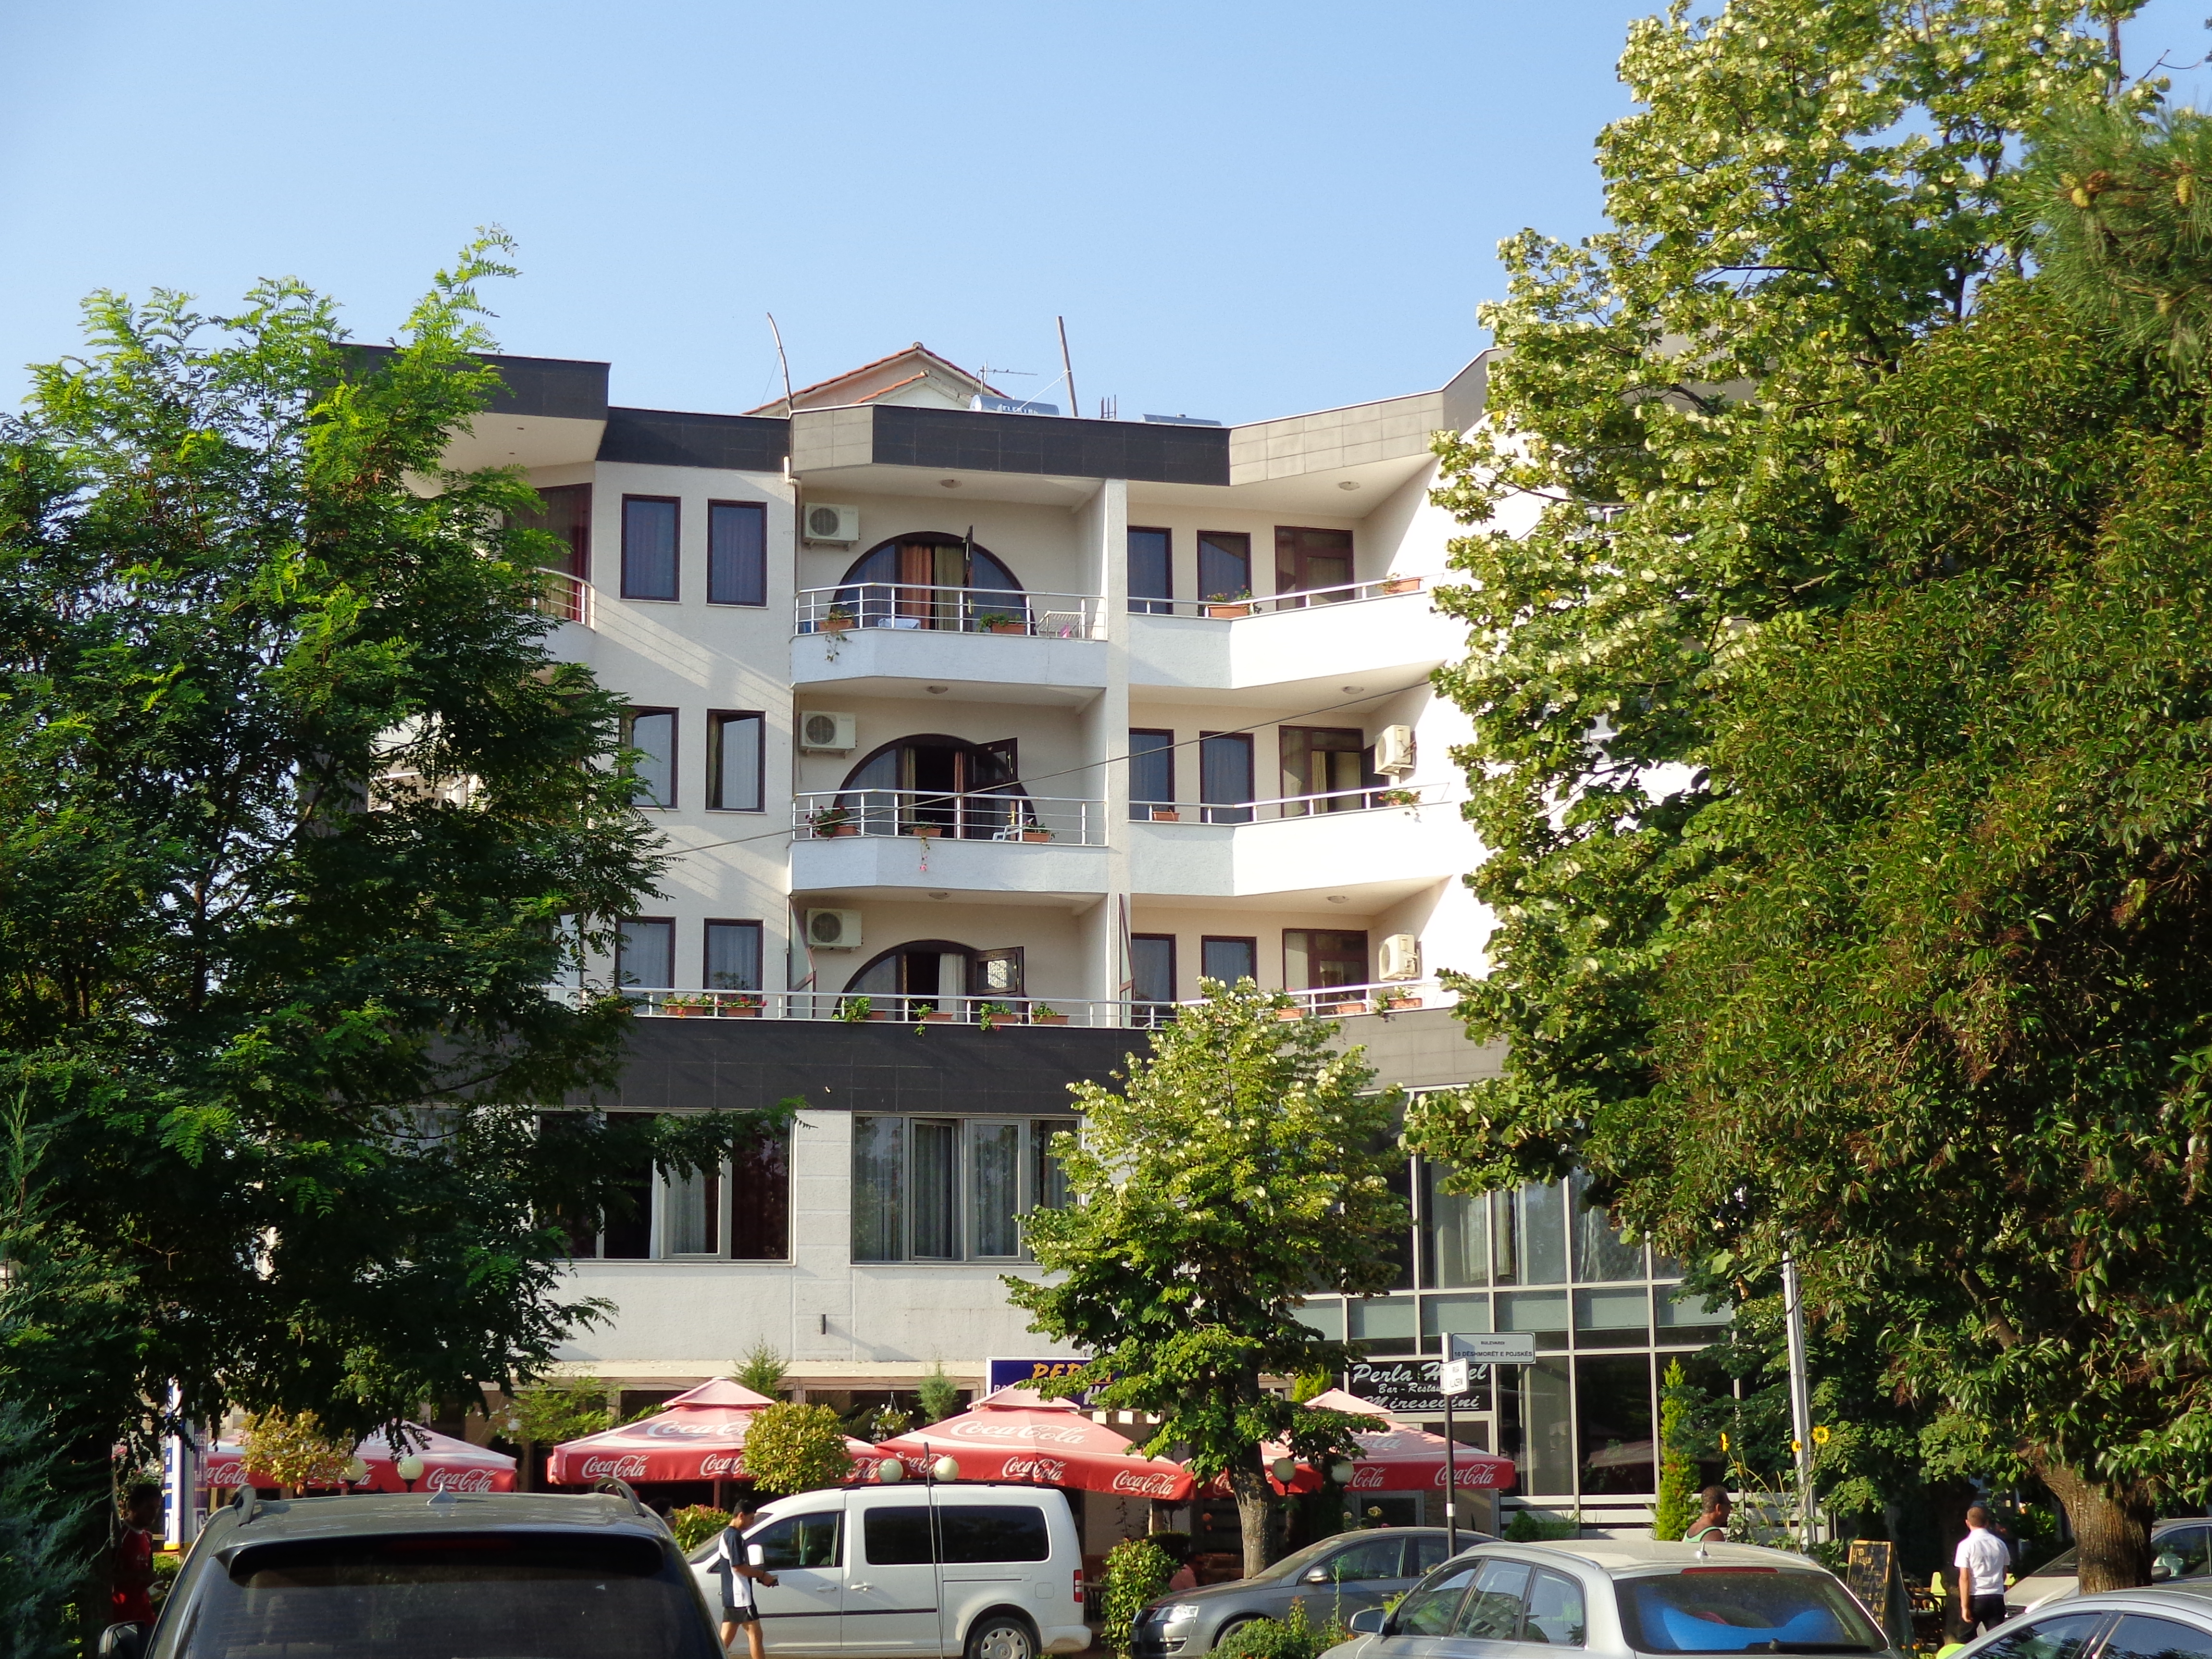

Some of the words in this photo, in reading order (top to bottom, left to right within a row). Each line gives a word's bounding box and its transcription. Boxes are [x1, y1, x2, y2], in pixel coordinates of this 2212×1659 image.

[1353, 1363, 1413, 1383] Perla
[1421, 1362, 1487, 1381] Hel
[1378, 1383, 1398, 1394] Bar
[1408, 1382, 1442, 1393] Restau
[647, 1420, 752, 1438] Coca-C
[950, 1421, 1090, 1444] Coca-Cola
[581, 1455, 650, 1479] Coca-Cola
[700, 1454, 755, 1476] Coca-C
[1002, 1456, 1067, 1480] Coca-Cola
[427, 1467, 498, 1492] Coca-Cola
[1112, 1470, 1178, 1495] Coca-Cola
